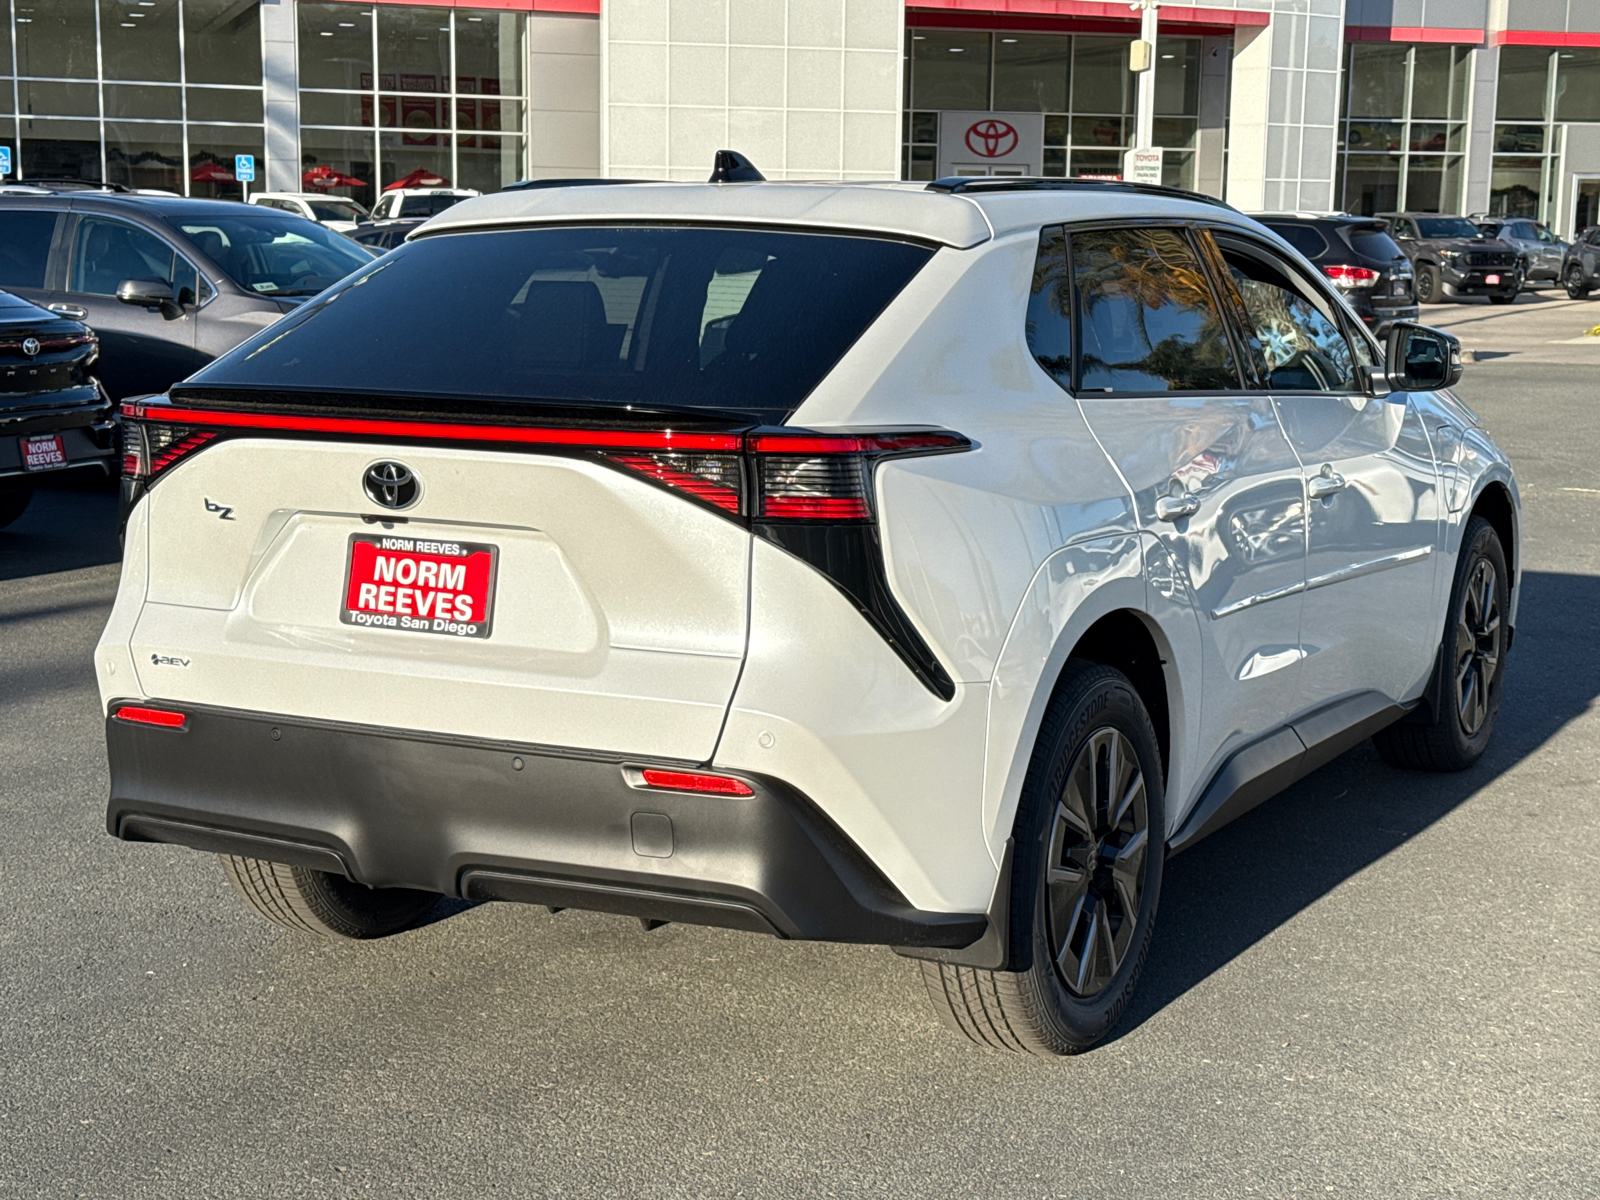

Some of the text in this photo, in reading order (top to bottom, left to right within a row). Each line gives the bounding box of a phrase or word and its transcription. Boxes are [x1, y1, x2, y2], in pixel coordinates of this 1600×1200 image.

[1136, 154, 1160, 162] TOYOTA
[28, 440, 57, 454] NORM
[26, 451, 63, 465] REEVES
[382, 538, 460, 555] NORM REEVES
[373, 555, 466, 591] NORM
[358, 583, 474, 621] REEVES
[349, 610, 477, 635] Toyota San Diego
[1050, 690, 1109, 806] BRIDGESTONE
